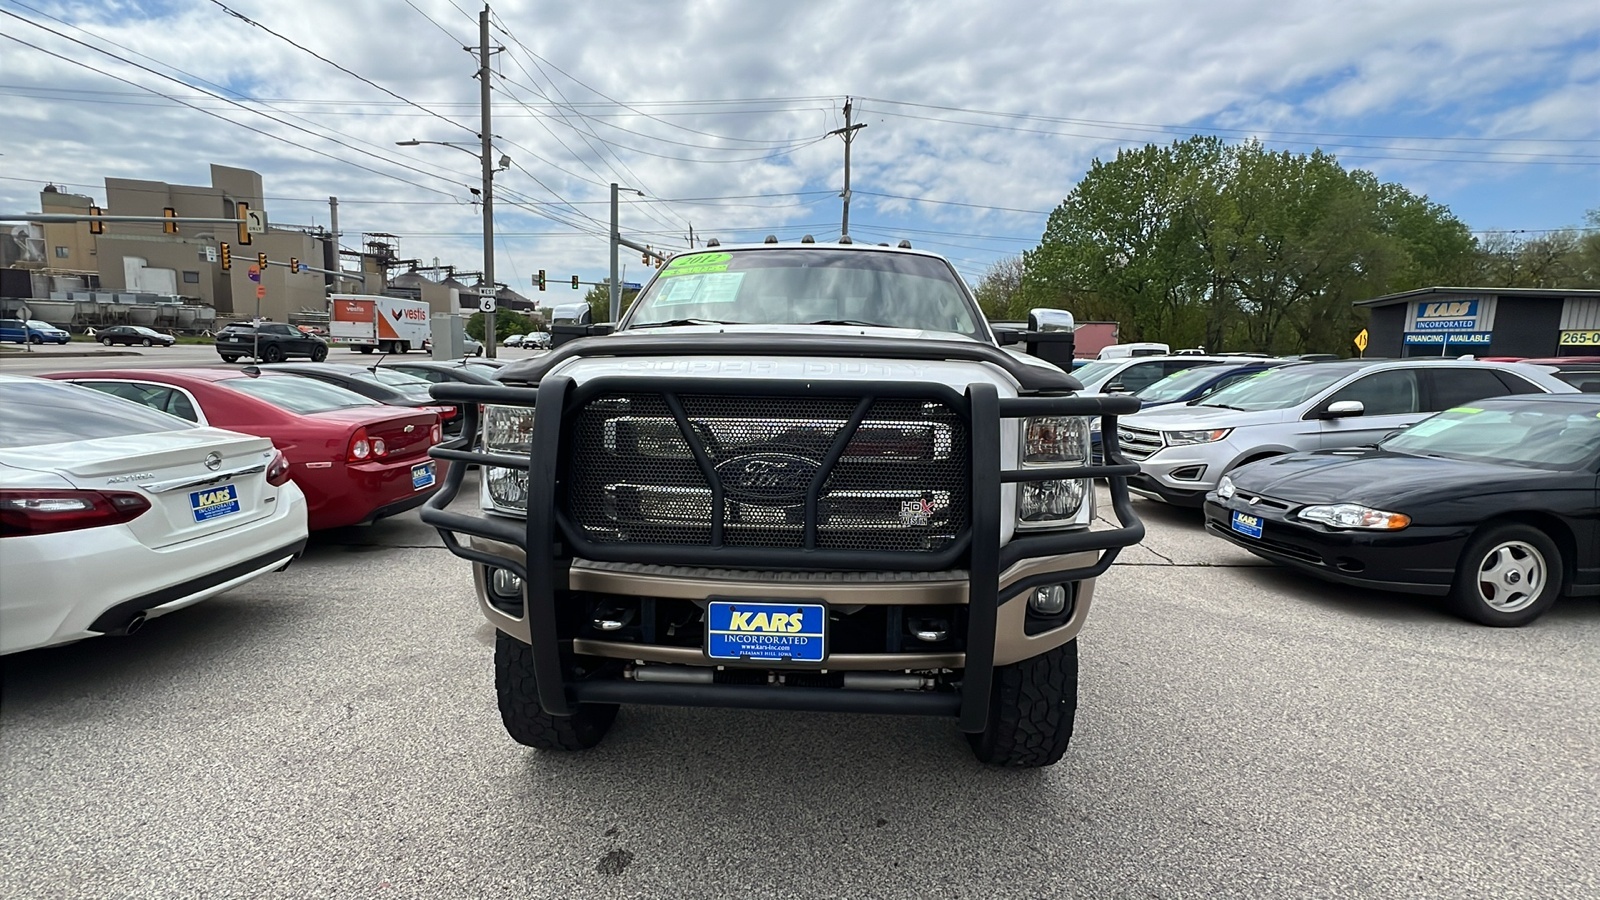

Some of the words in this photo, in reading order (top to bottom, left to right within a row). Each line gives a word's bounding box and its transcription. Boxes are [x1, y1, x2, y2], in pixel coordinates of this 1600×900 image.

[680, 255, 722, 265] 2012
[485, 300, 491, 310] 6
[1424, 302, 1471, 317] KARS
[404, 307, 426, 320] vestis
[620, 360, 778, 374] SUPER
[803, 362, 929, 377] DUTY
[107, 472, 155, 485] ALTIMA
[199, 489, 230, 506] KARS
[1237, 513, 1258, 526] KARS
[729, 612, 803, 633] KARS
[724, 634, 808, 645] INCORPORATED
